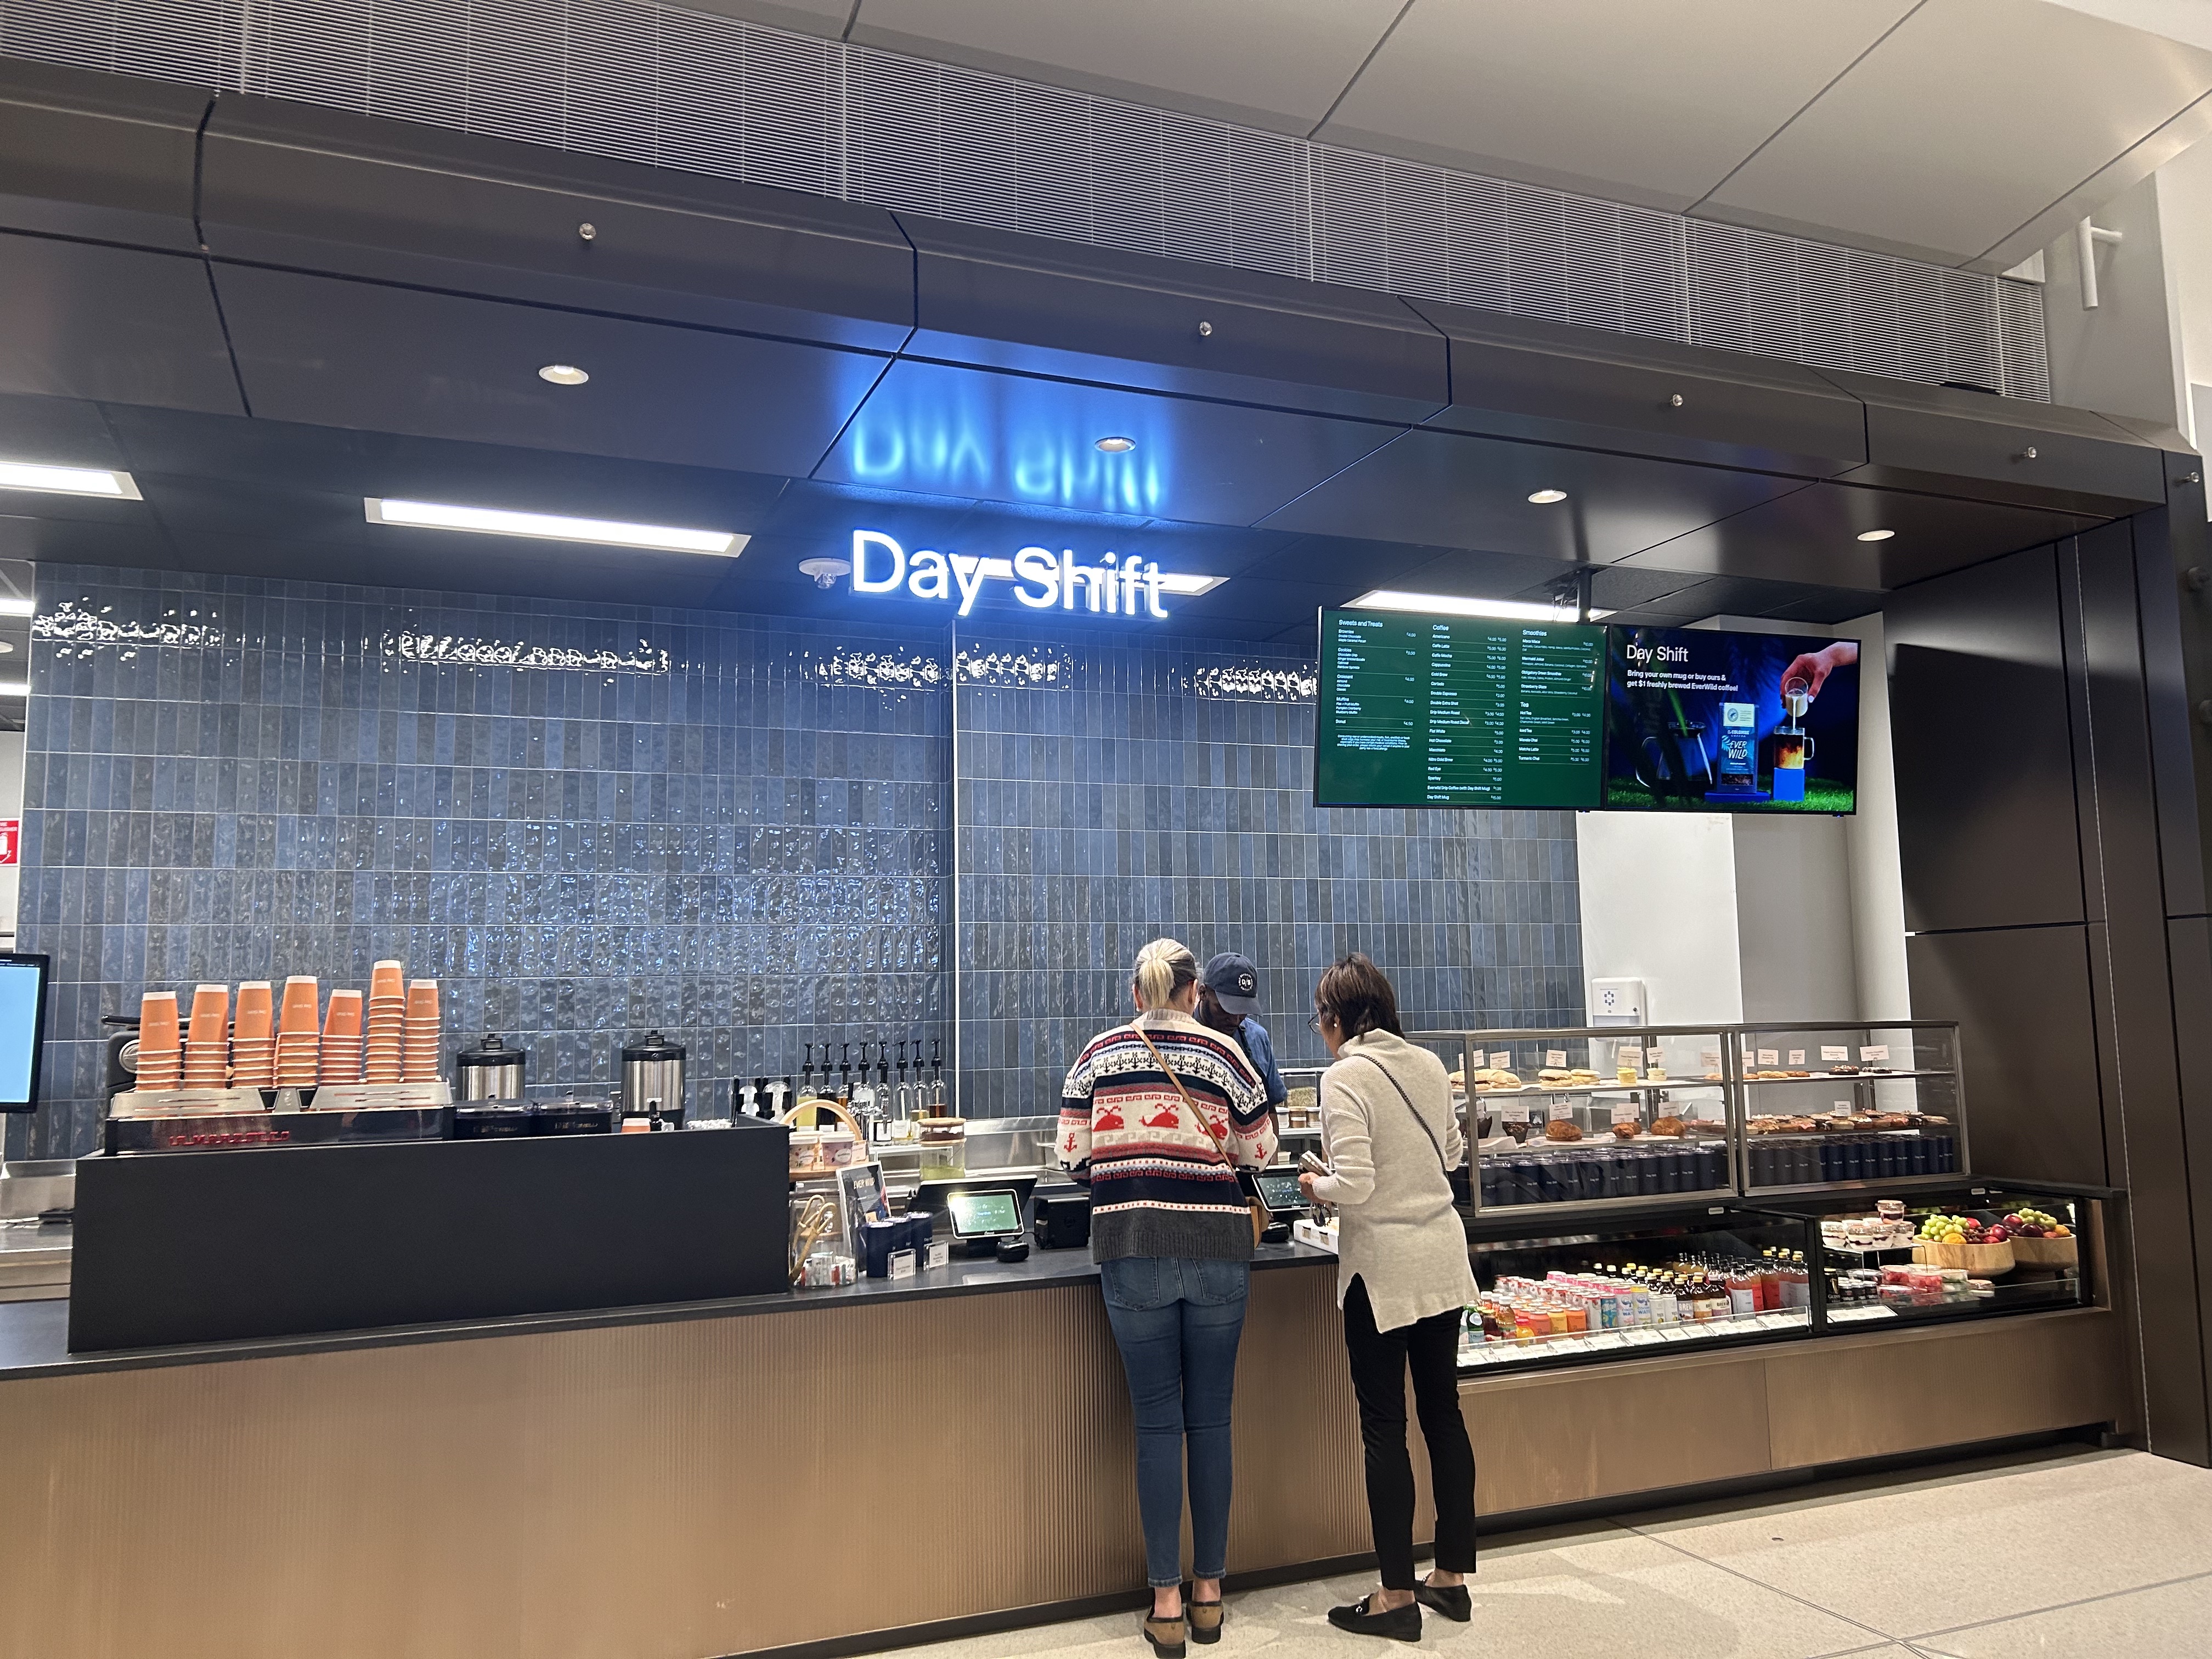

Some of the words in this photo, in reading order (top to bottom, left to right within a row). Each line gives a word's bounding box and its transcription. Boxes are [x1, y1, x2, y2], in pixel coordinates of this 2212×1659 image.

[852, 529, 986, 616] Day
[1014, 546, 1168, 618] Shift
[1627, 645, 1653, 663] Day
[1657, 646, 1689, 662] Shift
[1627, 670, 1644, 678] Bring
[1695, 673, 1706, 681] buy
[1647, 681, 1667, 689] freshly
[1728, 749, 1747, 759] WILD
[854, 1180, 865, 1189] EVER
[865, 1177, 874, 1187] WILD
